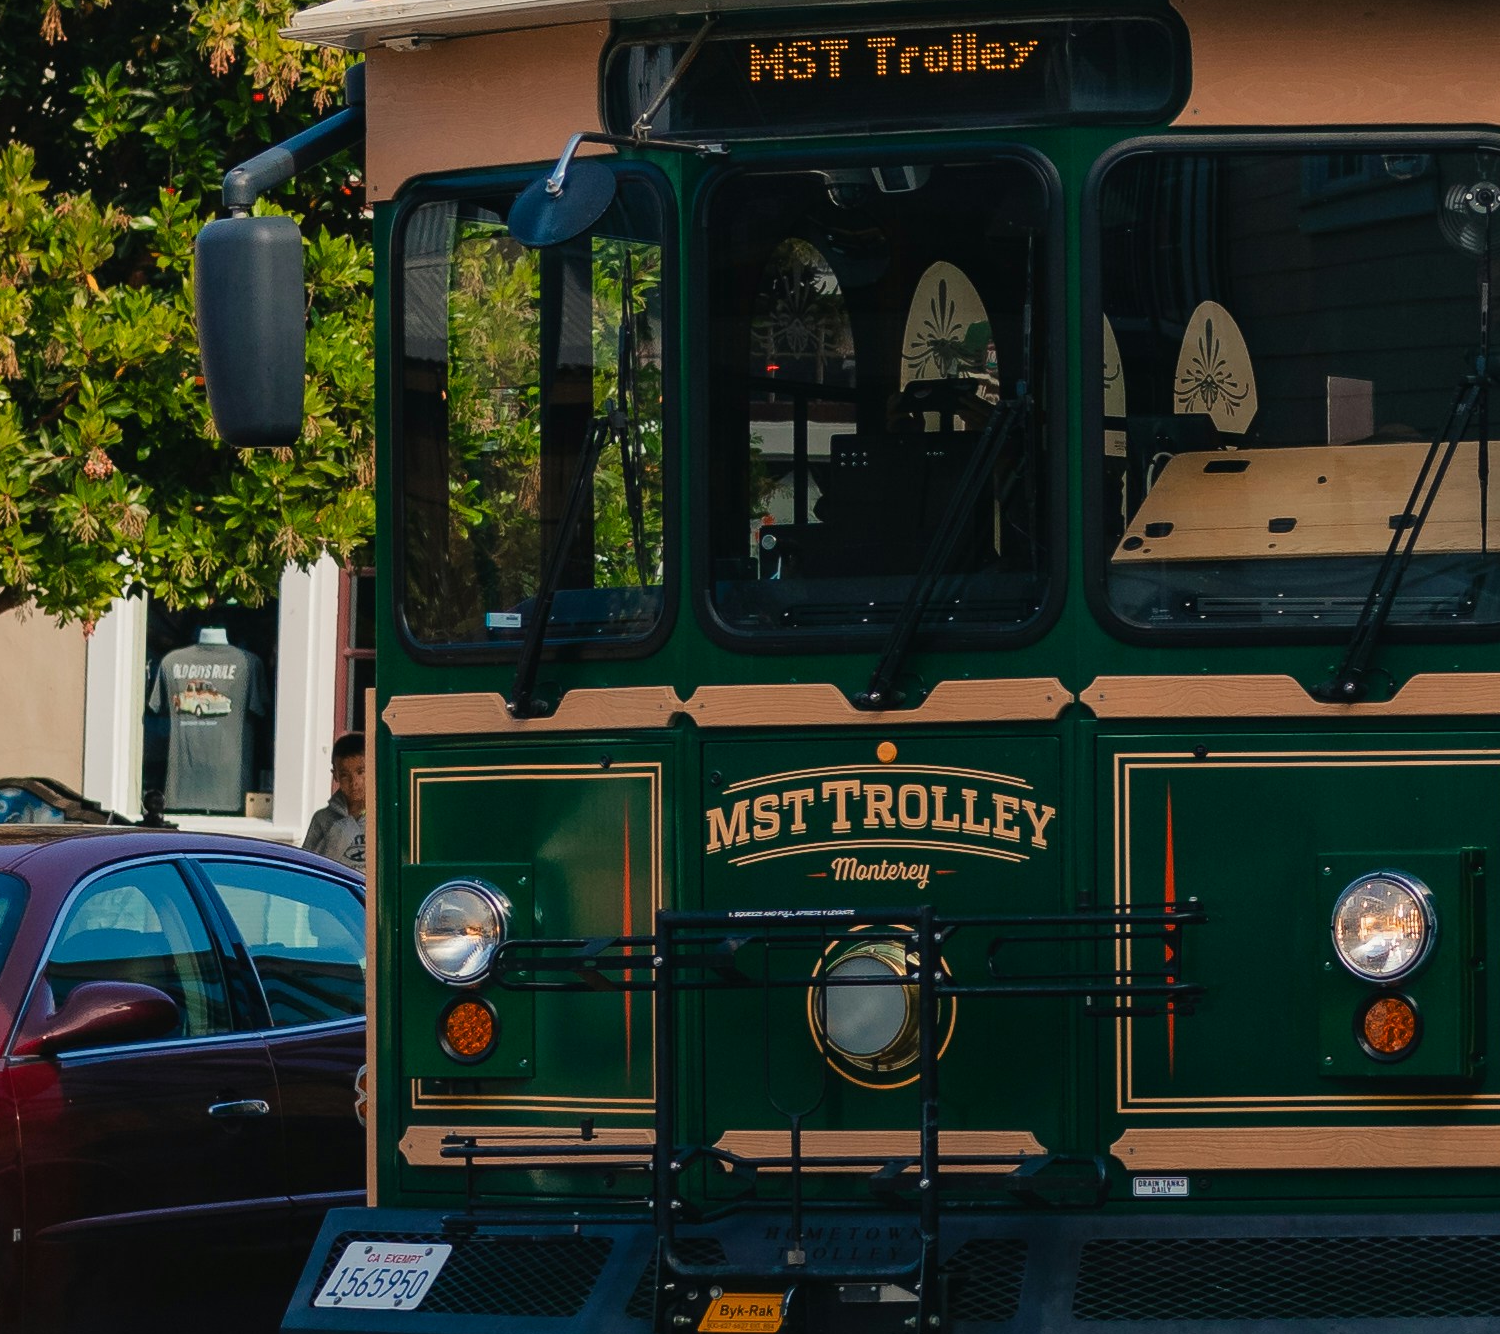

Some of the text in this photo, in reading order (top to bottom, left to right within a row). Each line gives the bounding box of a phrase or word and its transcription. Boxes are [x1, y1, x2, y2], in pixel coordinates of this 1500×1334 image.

[750, 32, 1039, 81] MST Trolley
[173, 663, 188, 679] OLD
[212, 664, 236, 679] RULE
[705, 779, 1056, 854] MST TROLLEY
[830, 857, 930, 889] Monterey
[1138, 1179, 1185, 1187] DRAIN TANKS
[367, 1253, 424, 1264] CA EXEMPT
[776, 1246, 903, 1261] TOLLEY
[326, 1266, 429, 1300] 1565950
[720, 1304, 774, 1319] Byk-Rak
